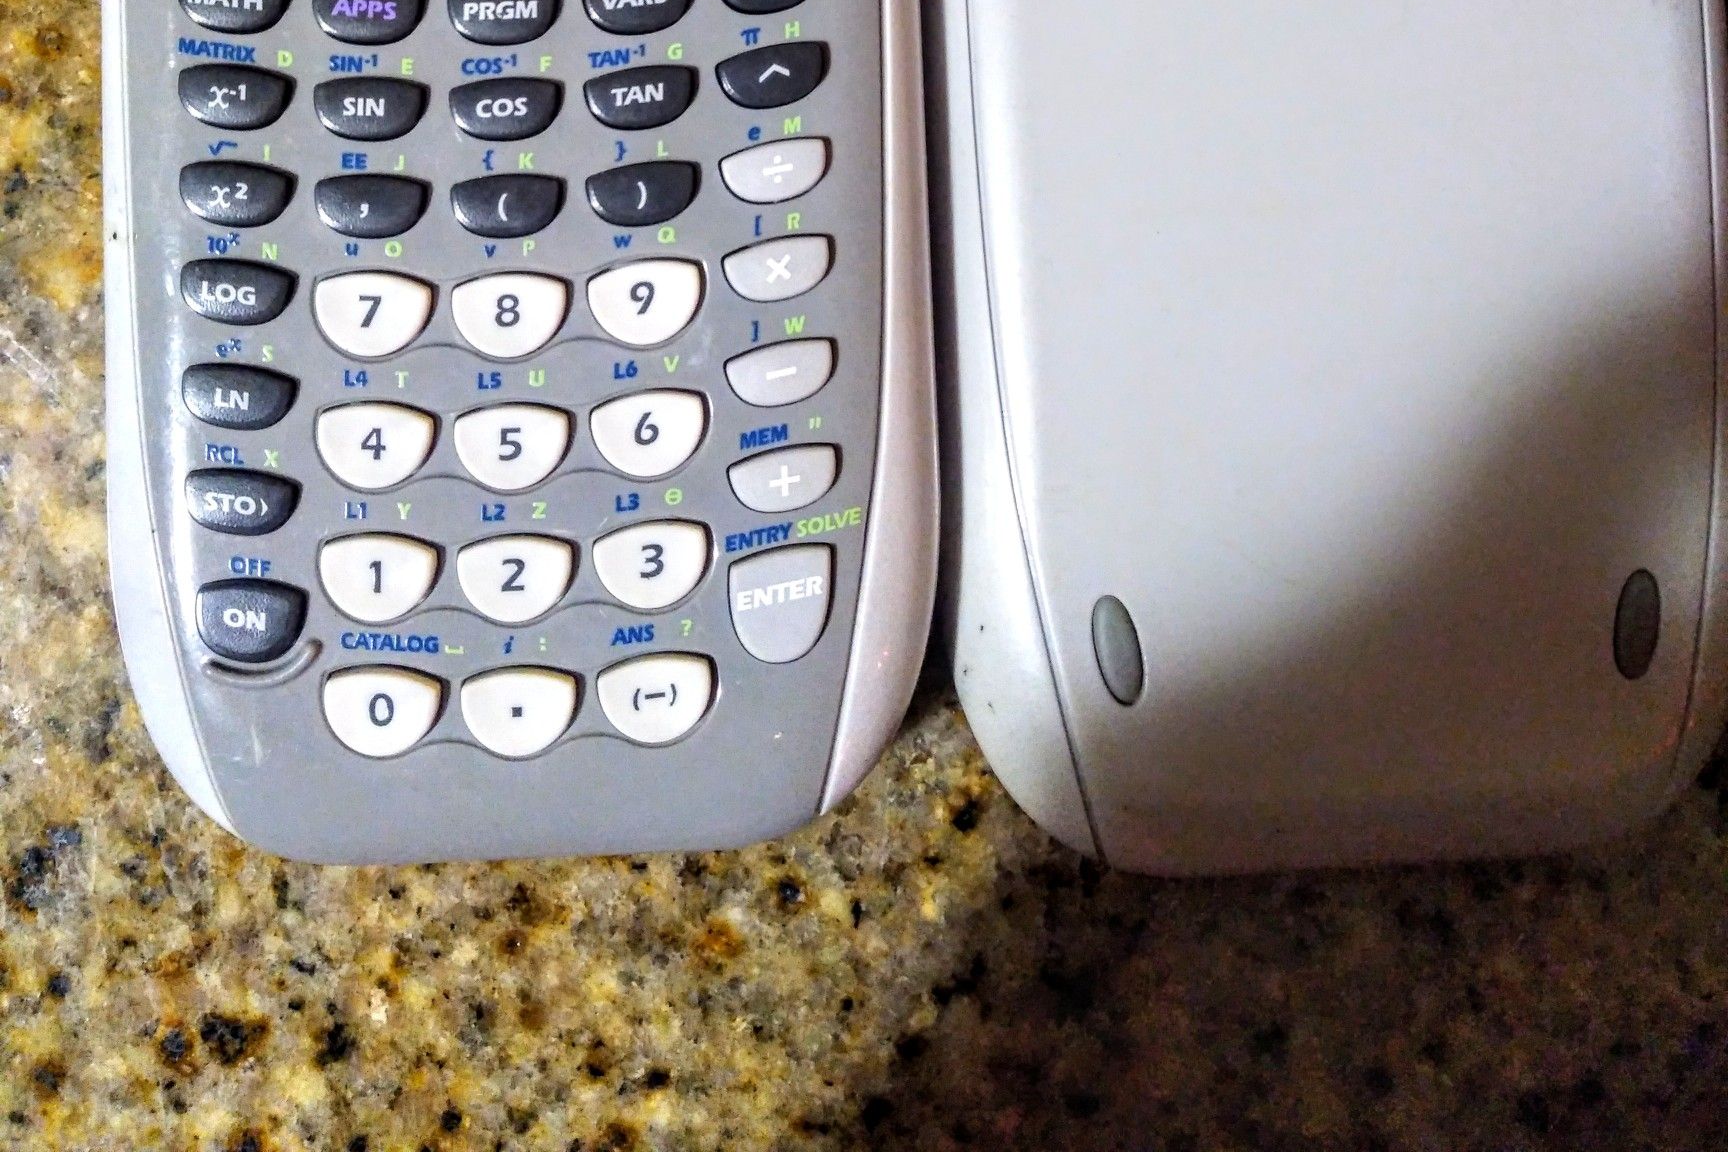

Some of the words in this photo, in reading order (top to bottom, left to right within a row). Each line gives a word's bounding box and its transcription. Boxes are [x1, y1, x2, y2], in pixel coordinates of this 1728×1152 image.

[463, 0, 538, 21] PRGM
[784, 22, 799, 39] H
[178, 37, 256, 62] MATRIX
[277, 50, 293, 67] D
[667, 43, 683, 60] G
[401, 57, 413, 75] E
[539, 56, 552, 72] F
[611, 83, 664, 107] TAN
[343, 97, 385, 117] SIN
[476, 98, 527, 118] COS
[748, 127, 760, 140] e
[785, 117, 802, 134] M
[658, 140, 668, 156] L
[342, 153, 367, 170] EE
[394, 154, 404, 171] J
[519, 153, 535, 170] K
[787, 212, 800, 230] R
[658, 227, 676, 243] Q
[262, 243, 277, 260] N
[523, 241, 535, 256] P
[199, 281, 256, 306] LOG
[630, 281, 655, 315] 9
[359, 295, 382, 328] 7
[494, 294, 520, 327] 8
[784, 316, 805, 334] W
[261, 346, 274, 363] S
[613, 362, 638, 380] L6
[663, 357, 679, 373] V
[344, 370, 368, 388] L4
[395, 372, 409, 388] T
[477, 373, 502, 389] L5
[529, 369, 544, 386] U
[214, 388, 249, 410] LN
[634, 411, 659, 446] 6
[739, 424, 789, 450] MEM
[360, 427, 386, 460] 4
[498, 428, 522, 461] 5
[205, 444, 244, 465] RCL
[264, 449, 279, 467] X
[344, 502, 367, 520] L1
[397, 502, 412, 520] Y
[532, 503, 547, 519] Z
[615, 494, 639, 512] L3
[481, 504, 505, 522] L2
[796, 508, 862, 538] SOLVE
[725, 522, 793, 553] ENTRY
[229, 556, 271, 576] OFF
[639, 544, 664, 580] 3
[369, 560, 381, 593] 1
[500, 558, 525, 592] 2
[736, 576, 823, 611] ENTER
[223, 609, 266, 632] ON
[681, 620, 693, 637] ?
[341, 632, 439, 654] CATALOG
[611, 624, 654, 646] ANS
[369, 693, 394, 727] 0
